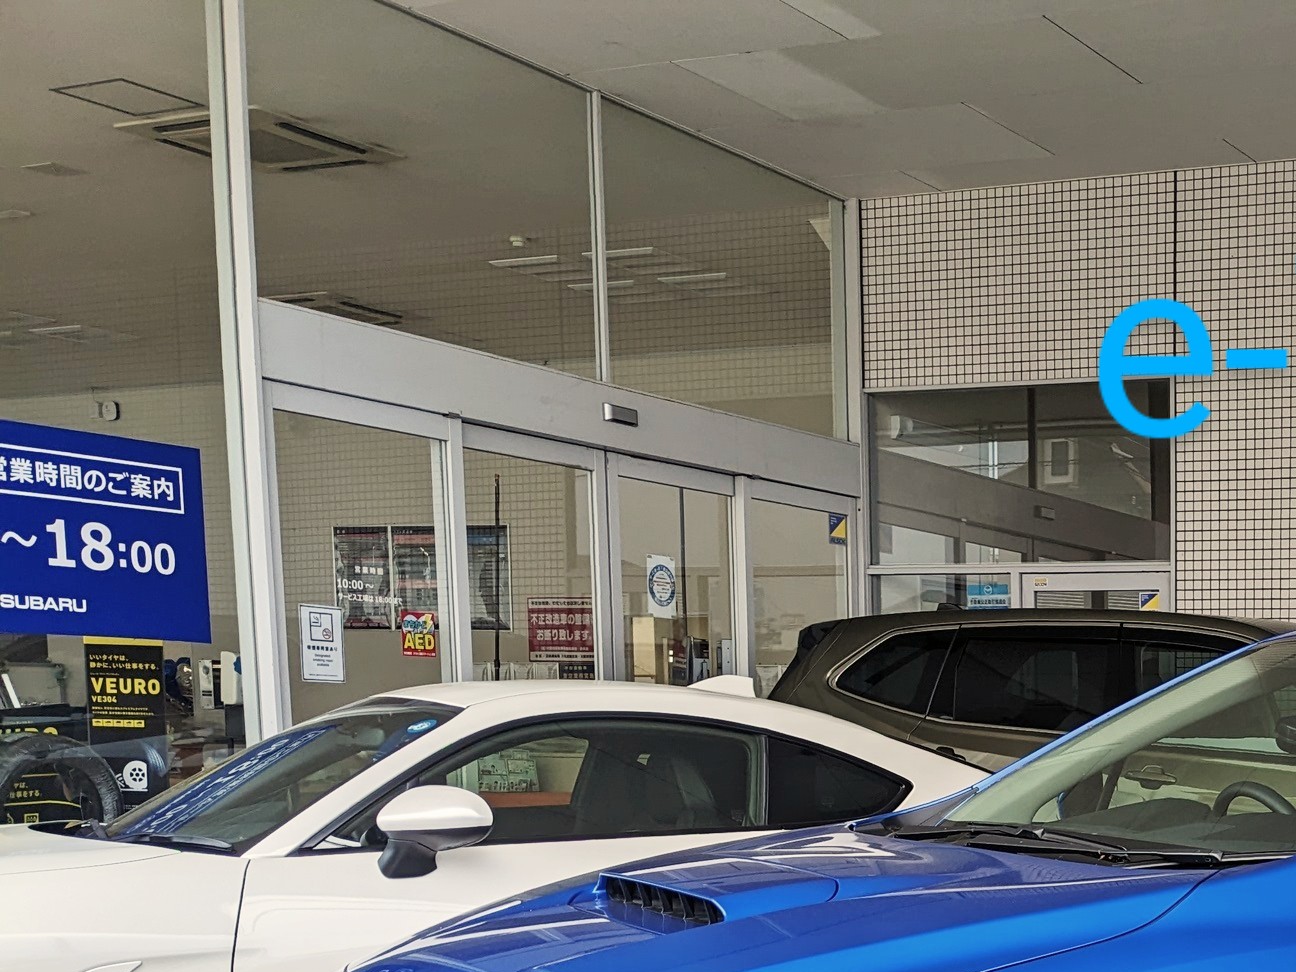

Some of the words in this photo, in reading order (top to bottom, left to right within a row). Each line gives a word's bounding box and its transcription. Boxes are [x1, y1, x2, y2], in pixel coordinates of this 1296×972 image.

[0, 594, 87, 613] SUBARU
[403, 633, 435, 650] AED
[90, 677, 161, 695] VEURO
[91, 695, 117, 703] VE304
